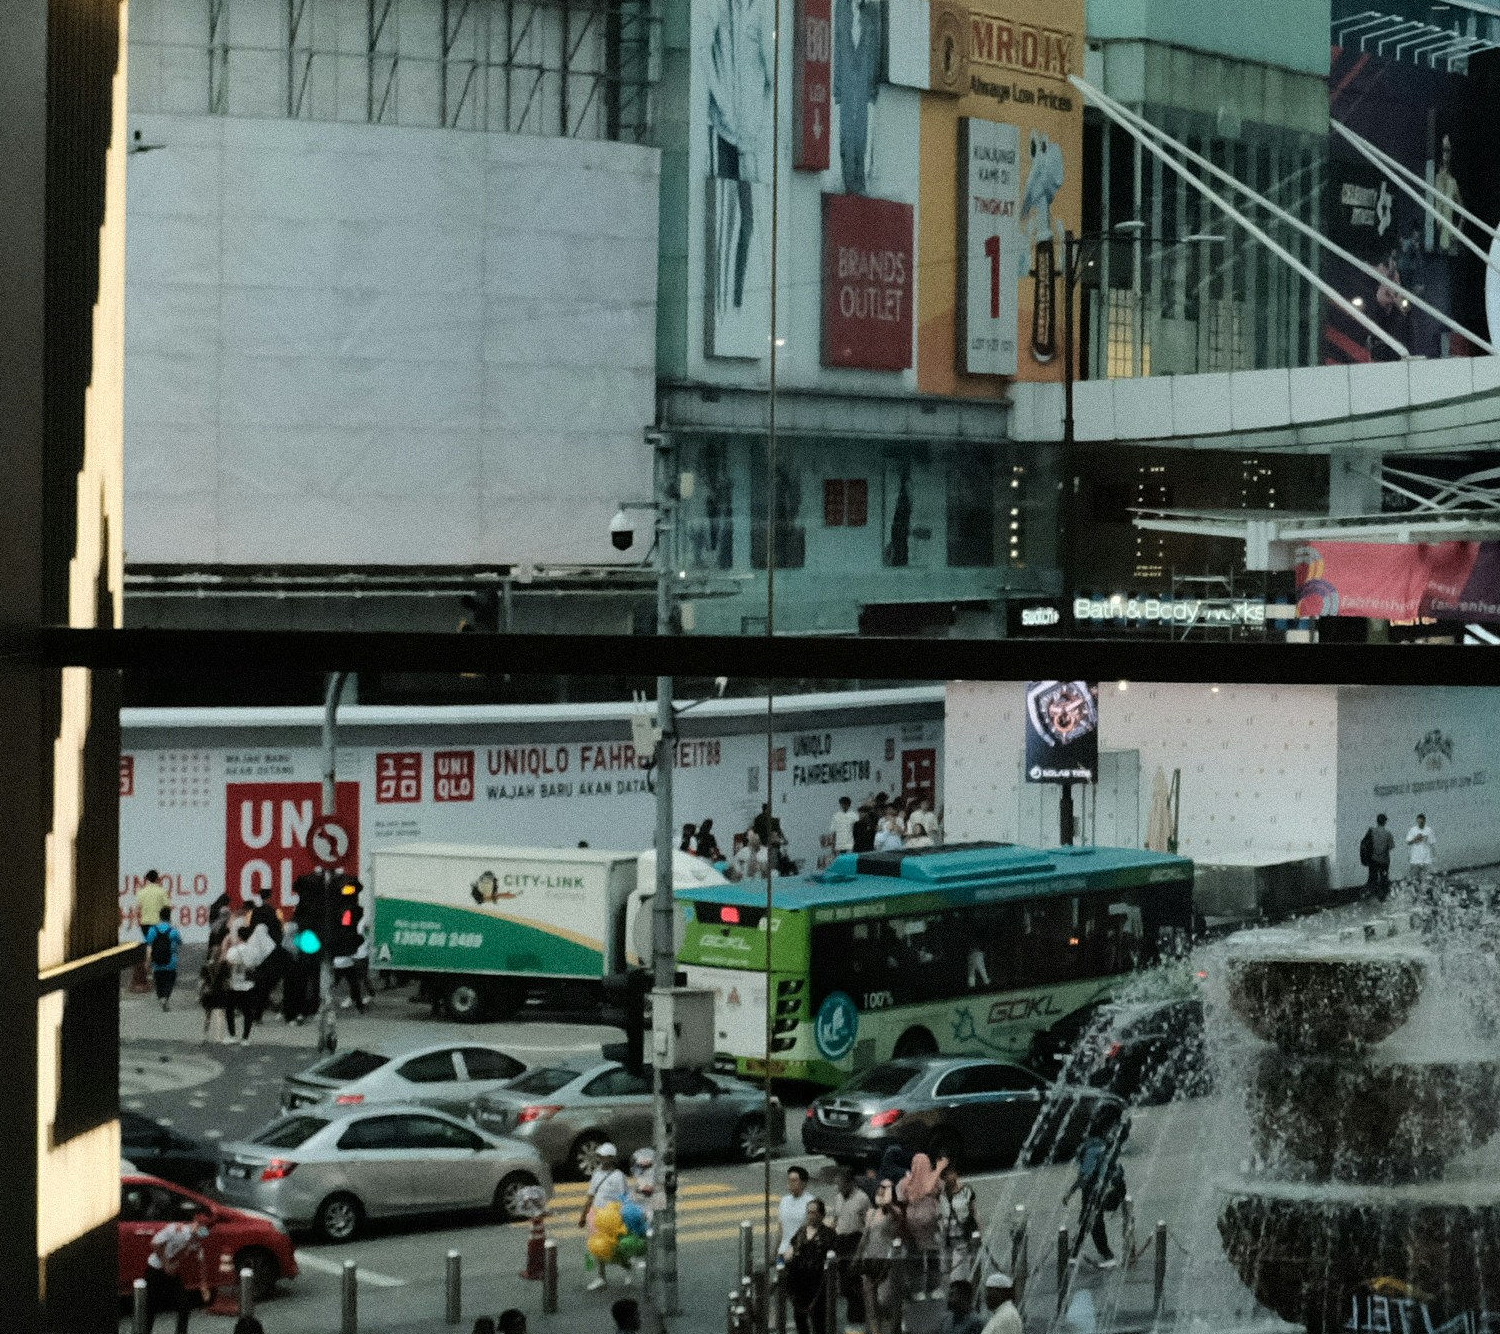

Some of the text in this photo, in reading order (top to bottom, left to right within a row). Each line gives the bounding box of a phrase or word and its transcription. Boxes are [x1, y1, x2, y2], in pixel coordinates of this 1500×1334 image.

[838, 247, 906, 285] BRANDS
[984, 234, 1002, 319] 1
[838, 283, 902, 324] OUTLET
[1073, 598, 1123, 620] Bath
[1126, 599, 1143, 620] &
[1145, 598, 1198, 623] Body
[792, 733, 832, 757] UNIQLO
[437, 758, 469, 776] UNI
[487, 746, 570, 779] UNIQLO
[437, 778, 471, 800] QLO
[487, 784, 535, 800] WAJAH
[540, 783, 574, 798] BARU
[579, 780, 612, 796] AKAN
[503, 873, 585, 890] CITY-LINK
[376, 945, 392, 962] A
[862, 990, 894, 1009] 100%
[987, 994, 1063, 1025] GOKL
